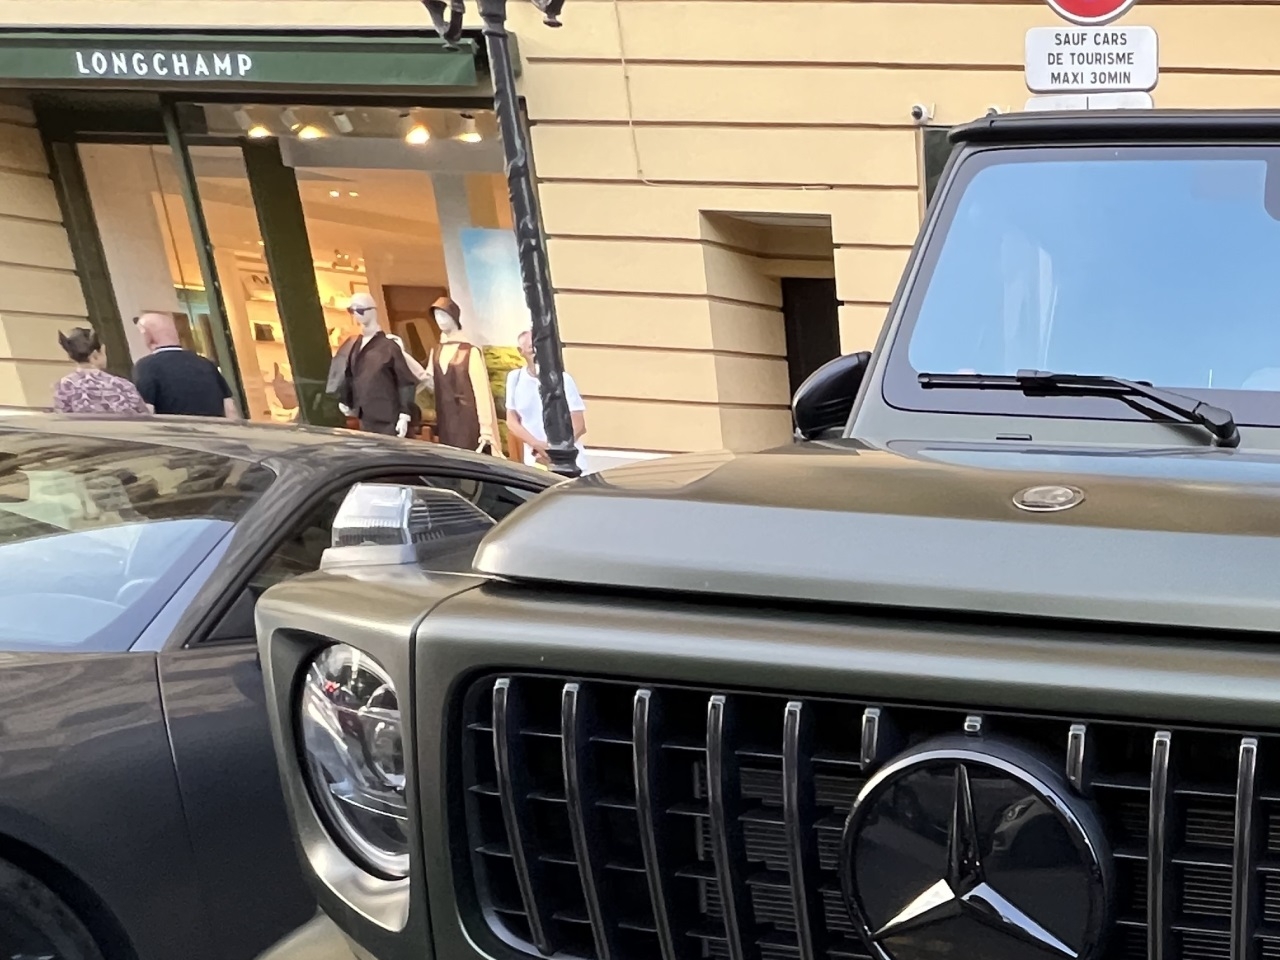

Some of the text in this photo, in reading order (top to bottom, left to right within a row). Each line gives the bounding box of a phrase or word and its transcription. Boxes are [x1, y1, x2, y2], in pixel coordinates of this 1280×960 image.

[1054, 32, 1128, 46] SAUF CARS
[75, 51, 253, 77] LONGCHAMP
[1047, 51, 1135, 66] DE TOURISME
[1050, 71, 1131, 85] MAXI 30MIN
